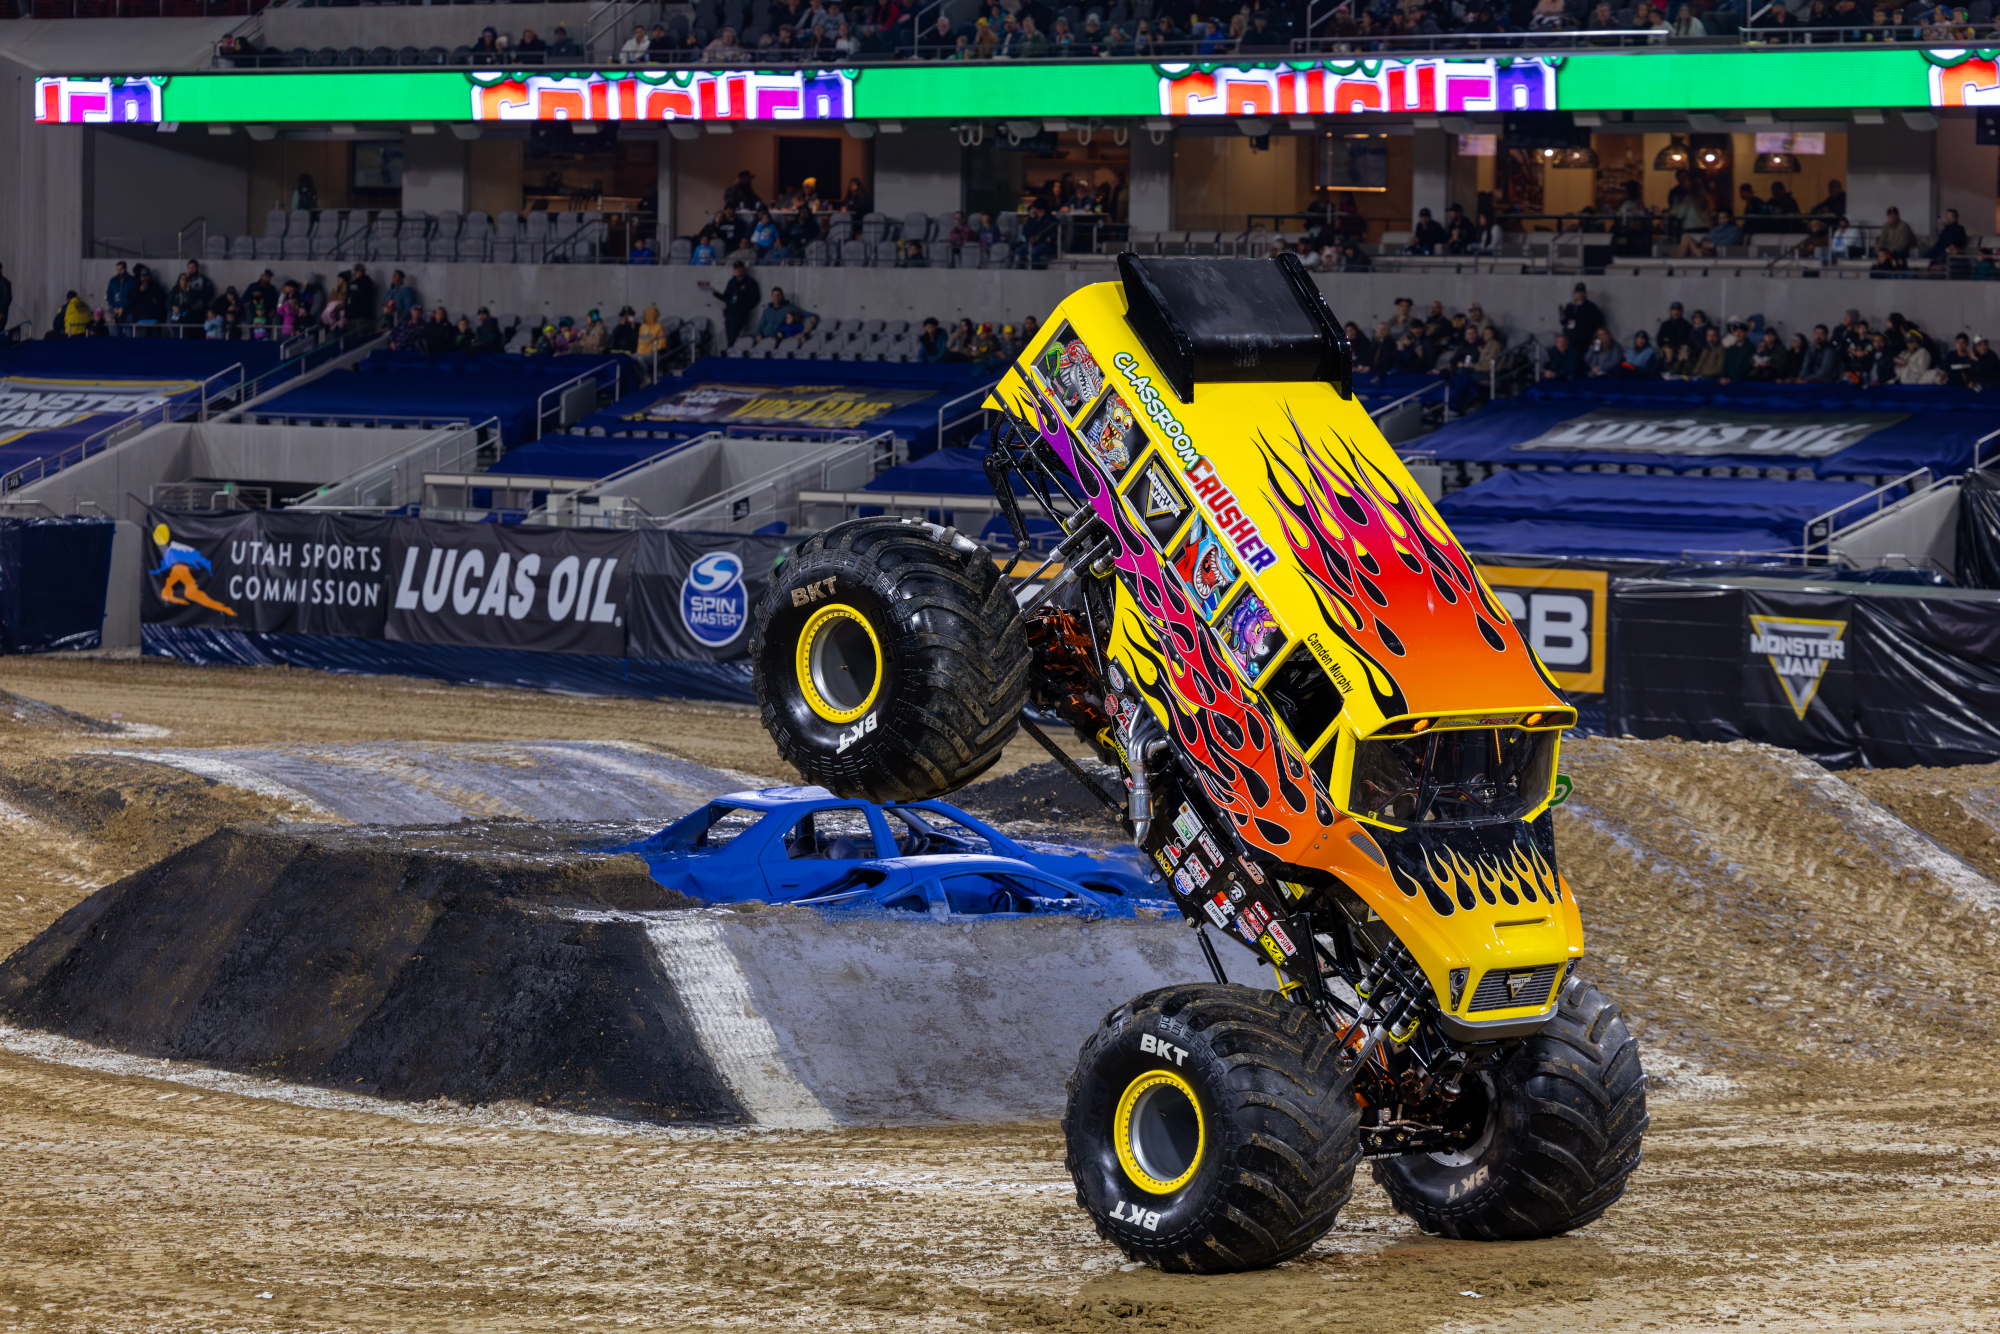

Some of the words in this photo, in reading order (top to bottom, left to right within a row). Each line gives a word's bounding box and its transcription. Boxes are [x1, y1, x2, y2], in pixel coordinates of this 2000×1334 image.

[1114, 352, 1200, 471] CLASSROOM
[1185, 457, 1278, 575] CRUSHER
[1146, 468, 1181, 518] MONSTER
[1150, 491, 1169, 512] JAM
[231, 541, 292, 566] UTAH
[300, 543, 381, 572] SPORTS
[229, 575, 379, 607] COMMISSION
[394, 546, 541, 620] LUCAS
[547, 555, 619, 624] OIL
[791, 576, 837, 607] BKT
[690, 596, 736, 614] SPIN
[1750, 633, 1845, 660] MONSTER
[1307, 633, 1333, 665] Camden
[1329, 663, 1353, 694] Murphy
[1777, 656, 1821, 678] JAM
[836, 711, 878, 764] BKT
[1176, 819, 1193, 840] BKT
[1202, 832, 1221, 858] LINCOLN
[1155, 849, 1174, 876] UNOH
[1255, 901, 1269, 921] Coan
[1270, 924, 1293, 952] SIMPSON
[1140, 1033, 1189, 1067] BKT
[1445, 1164, 1490, 1205] BKT
[1109, 1200, 1162, 1232] BKT
